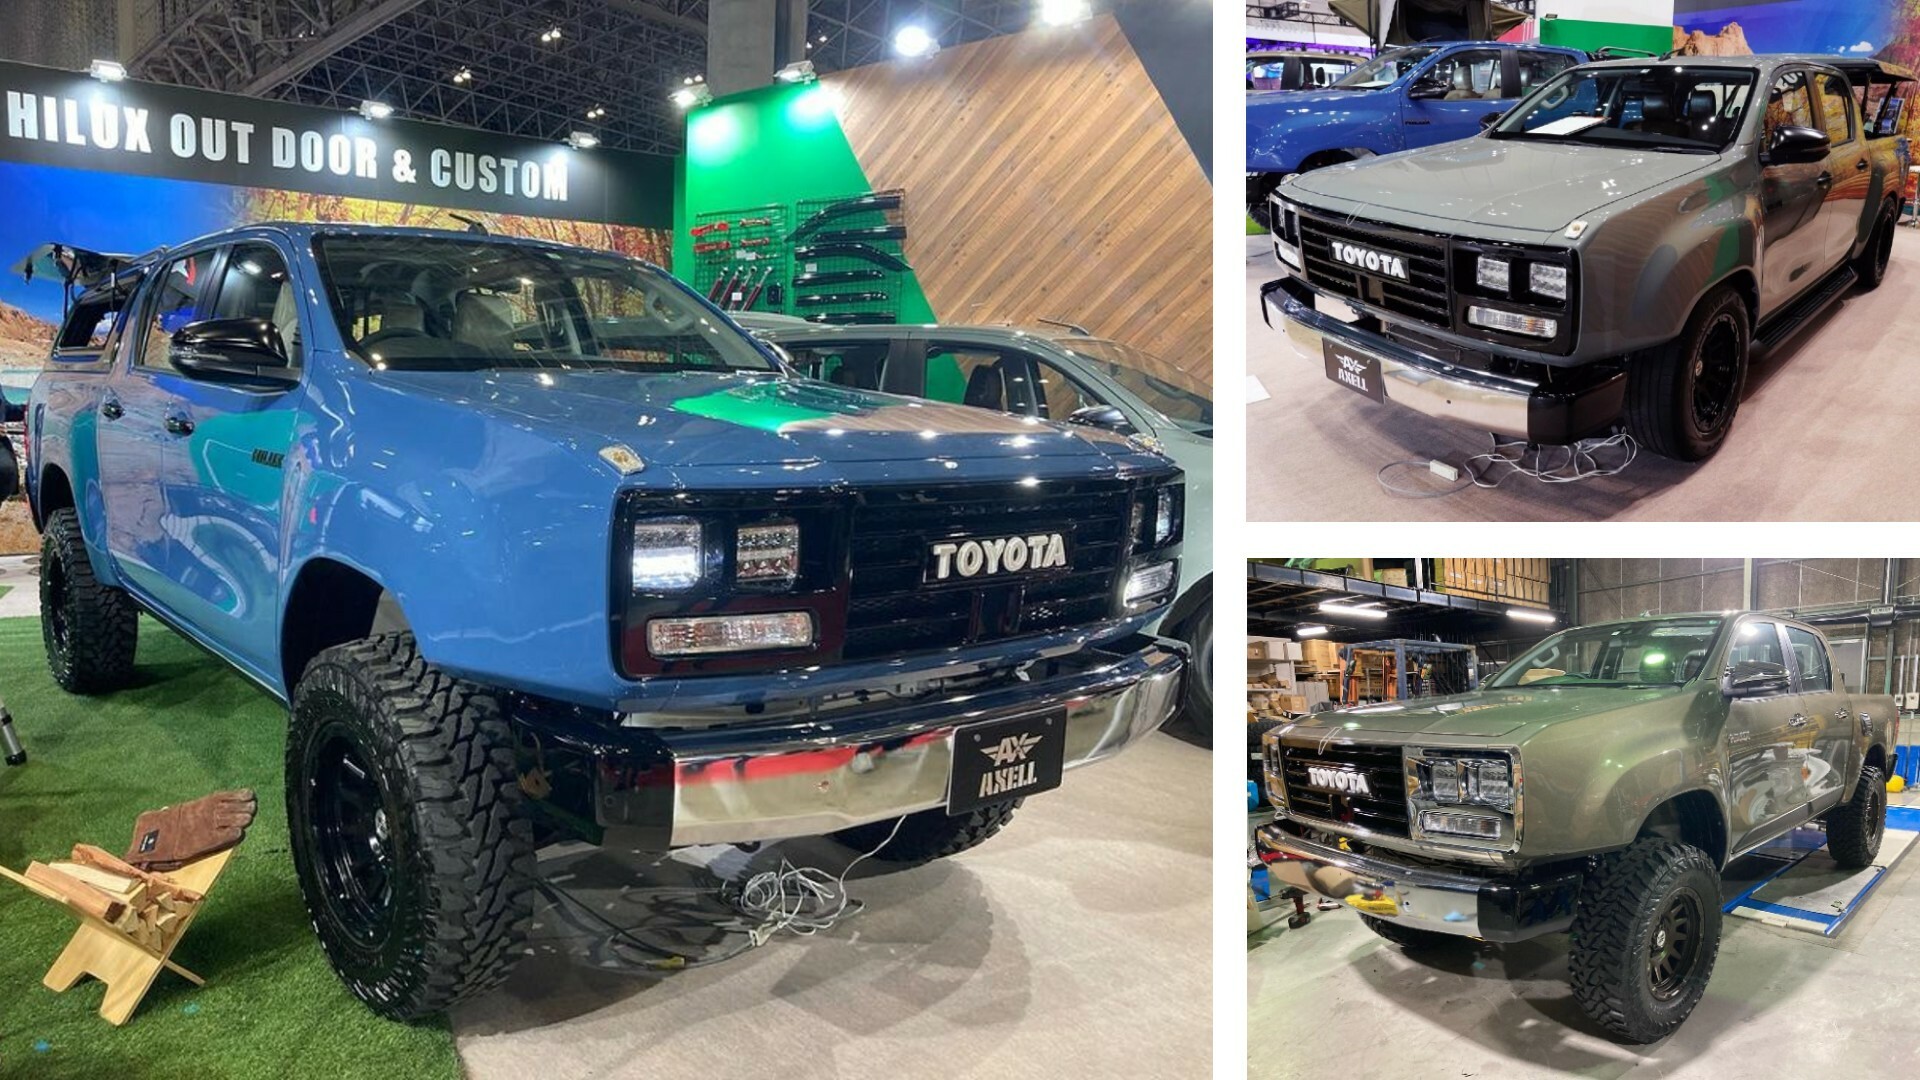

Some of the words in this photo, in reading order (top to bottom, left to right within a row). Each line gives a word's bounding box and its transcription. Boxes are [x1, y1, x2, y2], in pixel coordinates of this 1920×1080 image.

[7, 90, 152, 154] HILUX
[169, 113, 255, 165] OUT
[271, 126, 378, 179] DOOR
[391, 148, 417, 184] &
[430, 148, 569, 202] CUSTOM
[1331, 241, 1406, 279] TOYOTA
[1338, 367, 1369, 392] AXELL
[932, 533, 1067, 579] TOYOTA
[978, 760, 1038, 798] AXELL
[1307, 767, 1370, 794] TOYOTA
